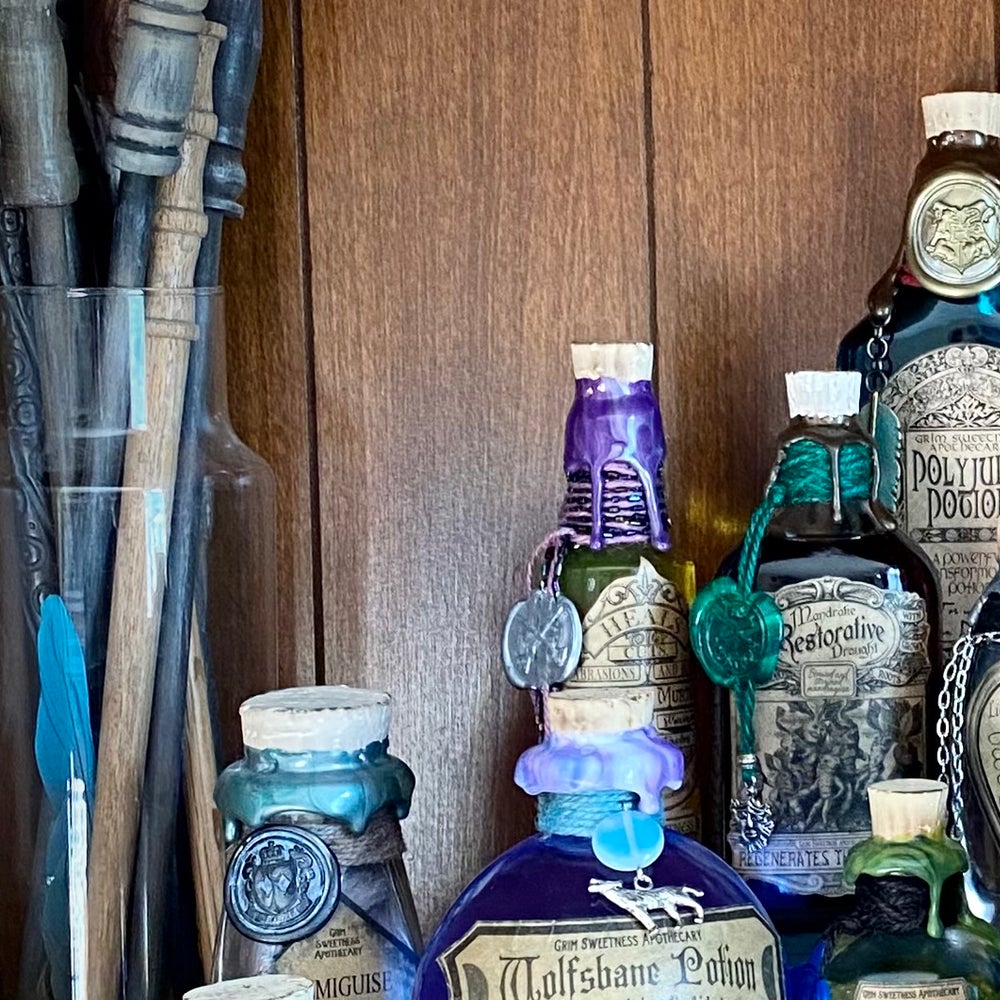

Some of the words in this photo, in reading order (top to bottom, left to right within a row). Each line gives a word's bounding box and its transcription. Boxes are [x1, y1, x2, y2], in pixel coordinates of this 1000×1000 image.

[789, 605, 856, 629] Mandrake
[782, 615, 885, 664] Restorative
[740, 850, 829, 867] REGENERATES
[554, 938, 578, 952] GRIM
[581, 935, 639, 951] SWEETNESS
[642, 929, 702, 946] APOTHECARY
[671, 944, 757, 992] Potion
[315, 970, 393, 1000] MIGUISE
